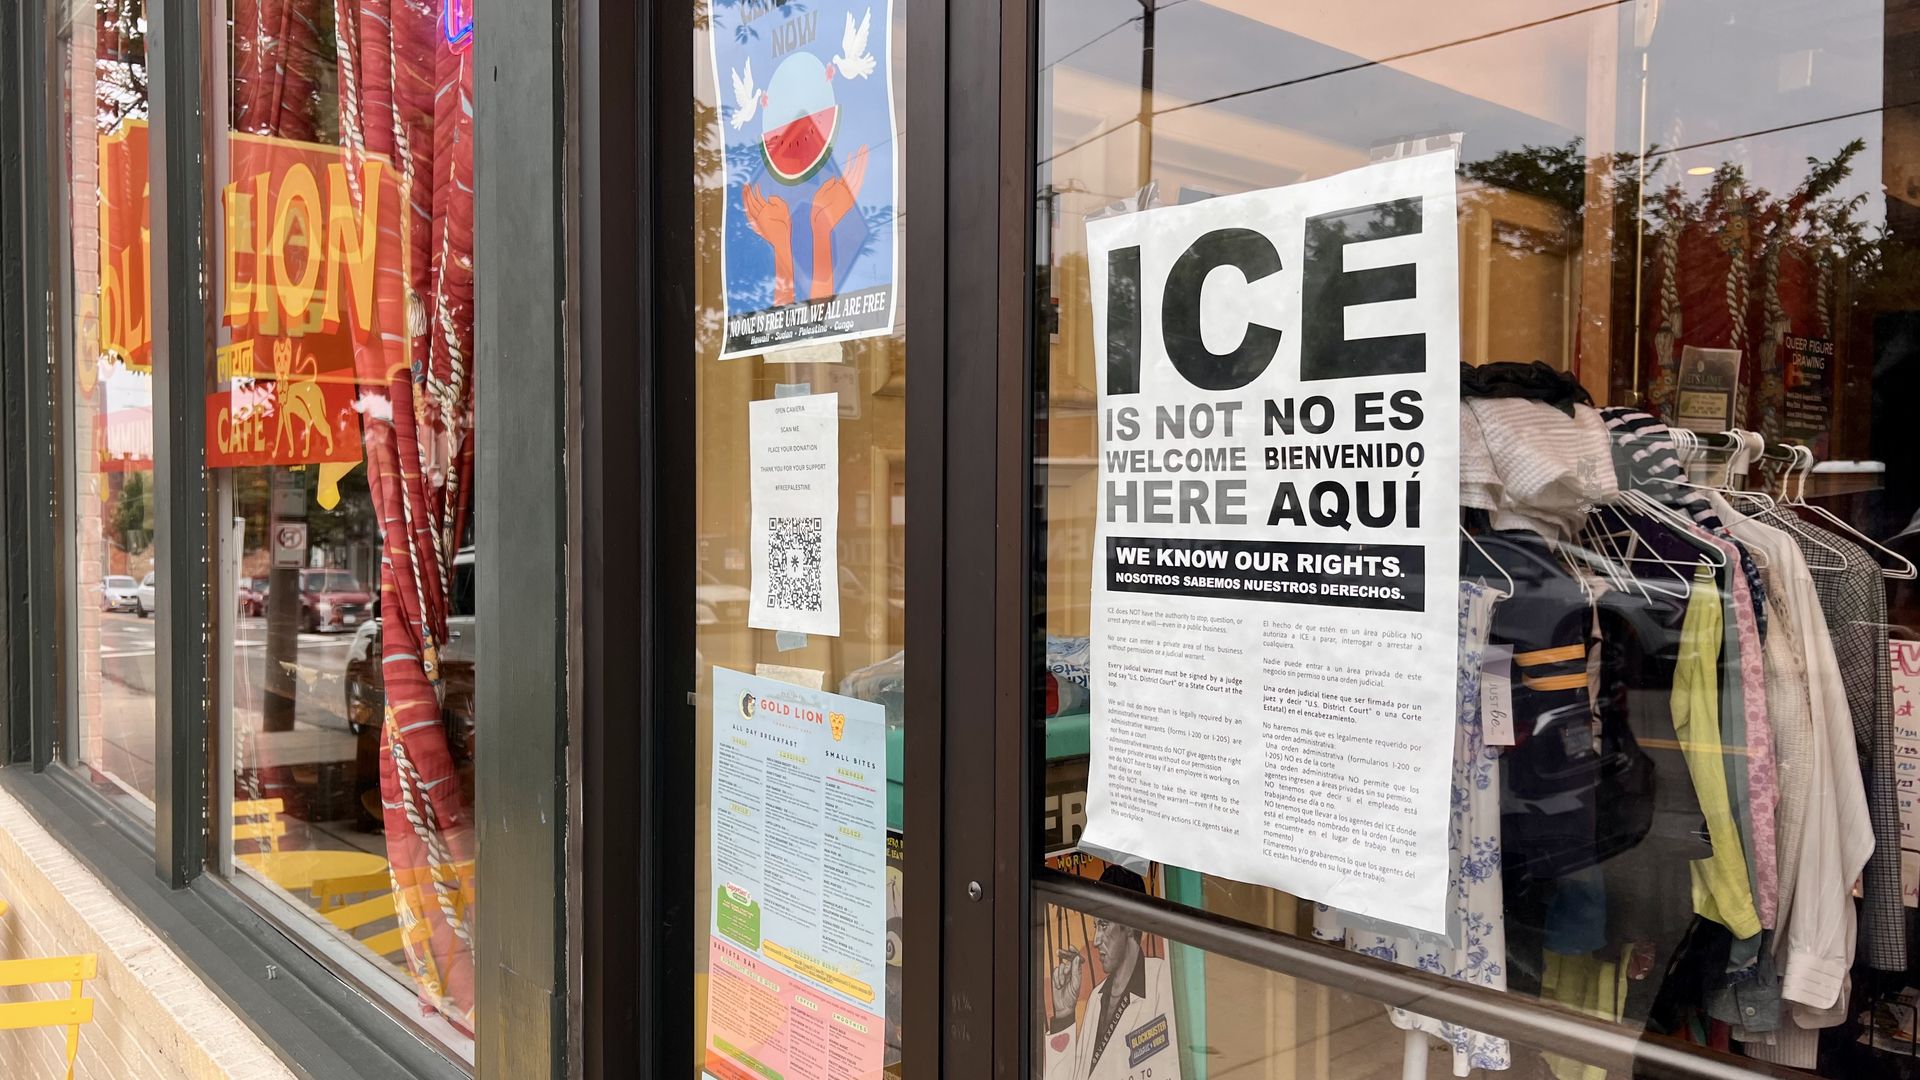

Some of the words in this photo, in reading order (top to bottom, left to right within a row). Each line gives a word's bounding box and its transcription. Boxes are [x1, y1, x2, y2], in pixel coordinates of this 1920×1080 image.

[772, 10, 818, 59] NOW
[223, 161, 384, 332] LION
[1107, 196, 1426, 395] ICE
[730, 320, 740, 337] NO
[741, 317, 755, 335] ONE
[757, 315, 764, 332] IS
[765, 312, 784, 330] FREE
[786, 307, 808, 327] UNTIL
[810, 304, 824, 322] WE
[825, 300, 841, 320] ALL
[842, 295, 861, 317] ARE
[862, 292, 886, 314] FREE
[1786, 336, 1808, 350] QUEER
[1809, 340, 1834, 355] FIGURE
[1793, 353, 1824, 369] DRAWING
[1107, 408, 1140, 441] IS
[1156, 401, 1243, 440] NOT
[1264, 395, 1335, 436] NO
[1355, 390, 1424, 432] ES
[1107, 447, 1246, 473] WELCOME
[1265, 442, 1425, 470] BIENVENIDO
[1107, 480, 1247, 524] HERE
[1267, 471, 1421, 531] AQUÍ
[1116, 547, 1150, 565] WE
[1157, 548, 1228, 569] KNOW
[1235, 551, 1289, 572] OUR
[1298, 554, 1405, 578] RIGHTS.
[1116, 572, 1180, 586] NOSOTROS
[1183, 577, 1240, 590] SABEMOS
[1244, 580, 1317, 595] NUESTROS
[1320, 583, 1405, 600] DERECHOS.
[1165, 612, 1189, 622] authority
[1197, 615, 1208, 623] stop,
[1210, 617, 1235, 625] question,
[1306, 624, 1316, 632] que
[1320, 625, 1336, 633] estén
[1364, 628, 1377, 637] área
[1382, 629, 1406, 639] pública
[1108, 662, 1122, 672] Every
[1123, 664, 1141, 673] judicial
[1189, 673, 1207, 682] signed
[1210, 674, 1217, 683] by
[1226, 676, 1242, 686] judge
[1140, 676, 1158, 684] District
[1190, 682, 1204, 690] State
[1206, 685, 1223, 693] Court
[1232, 687, 1242, 695] the
[1263, 694, 1276, 702] juez
[1287, 697, 1301, 706] decir
[1323, 702, 1345, 712] District
[1385, 711, 1397, 719] una
[1402, 712, 1422, 721] Corte
[1264, 685, 1275, 693] Una
[1278, 687, 1295, 695] orden
[1297, 689, 1319, 698] judicial
[1322, 692, 1337, 700] tiene
[1340, 696, 1352, 704] que
[1368, 698, 1394, 708] firmada
[1490, 683, 1498, 710] JUST
[761, 700, 790, 716] GOLD
[795, 708, 823, 725] LION
[1264, 704, 1286, 714] Estatal)
[1304, 710, 1356, 723] encabezamiento.
[732, 724, 743, 732] ALL
[745, 727, 757, 737] DAY
[760, 730, 798, 748] BREAKFAST
[825, 750, 849, 762] SMALL
[853, 757, 876, 770] BITES
[1263, 839, 1297, 852] Filmaremos
[1310, 850, 1346, 864] grabaremos
[1355, 860, 1366, 868] que
[1368, 862, 1377, 870] los
[1379, 866, 1403, 877] agentes
[1405, 870, 1415, 879] del
[1263, 849, 1272, 857] ICE
[1274, 852, 1289, 861] están
[1290, 855, 1318, 867] haciendo
[1337, 864, 1352, 875] lugar
[1353, 868, 1361, 876] de
[713, 942, 741, 961] BARISTA
[744, 958, 756, 970] BAR
[833, 1014, 868, 1032] SMOOTHIES
